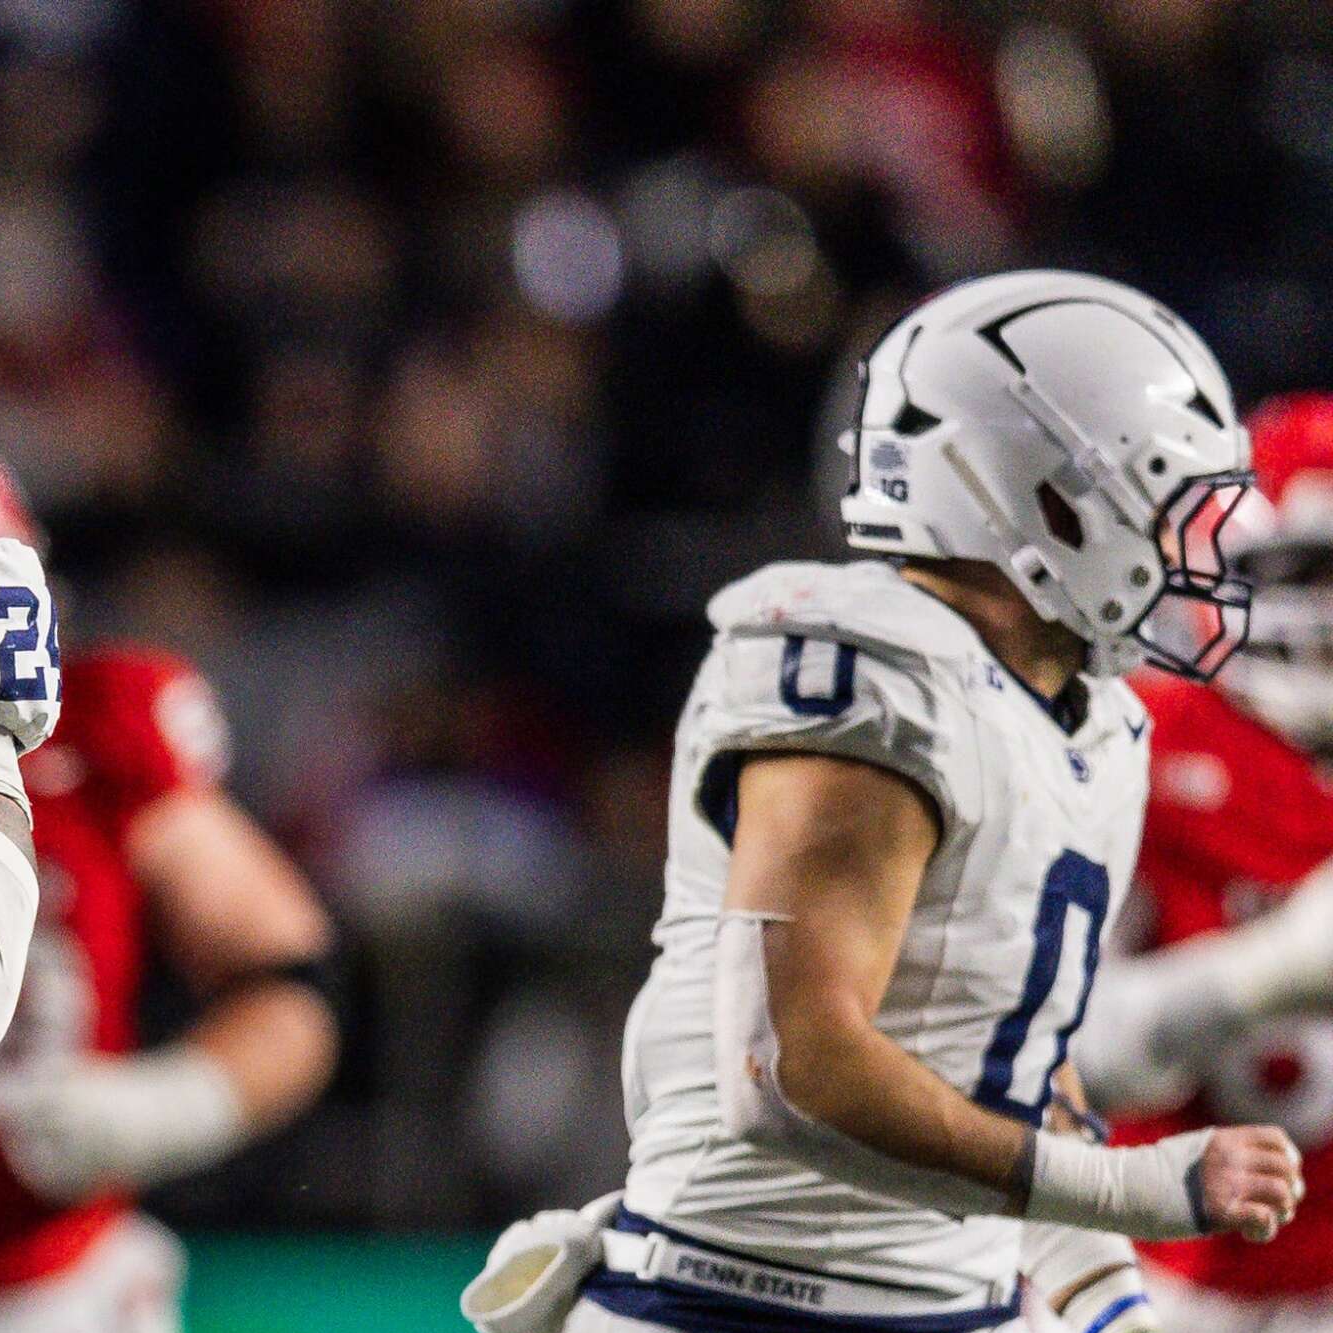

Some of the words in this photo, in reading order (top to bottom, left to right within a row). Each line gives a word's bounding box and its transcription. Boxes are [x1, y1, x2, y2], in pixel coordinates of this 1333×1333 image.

[973, 848, 1111, 1128] 0
[676, 1254, 745, 1289] PENN
[752, 1270, 827, 1305] STATE
